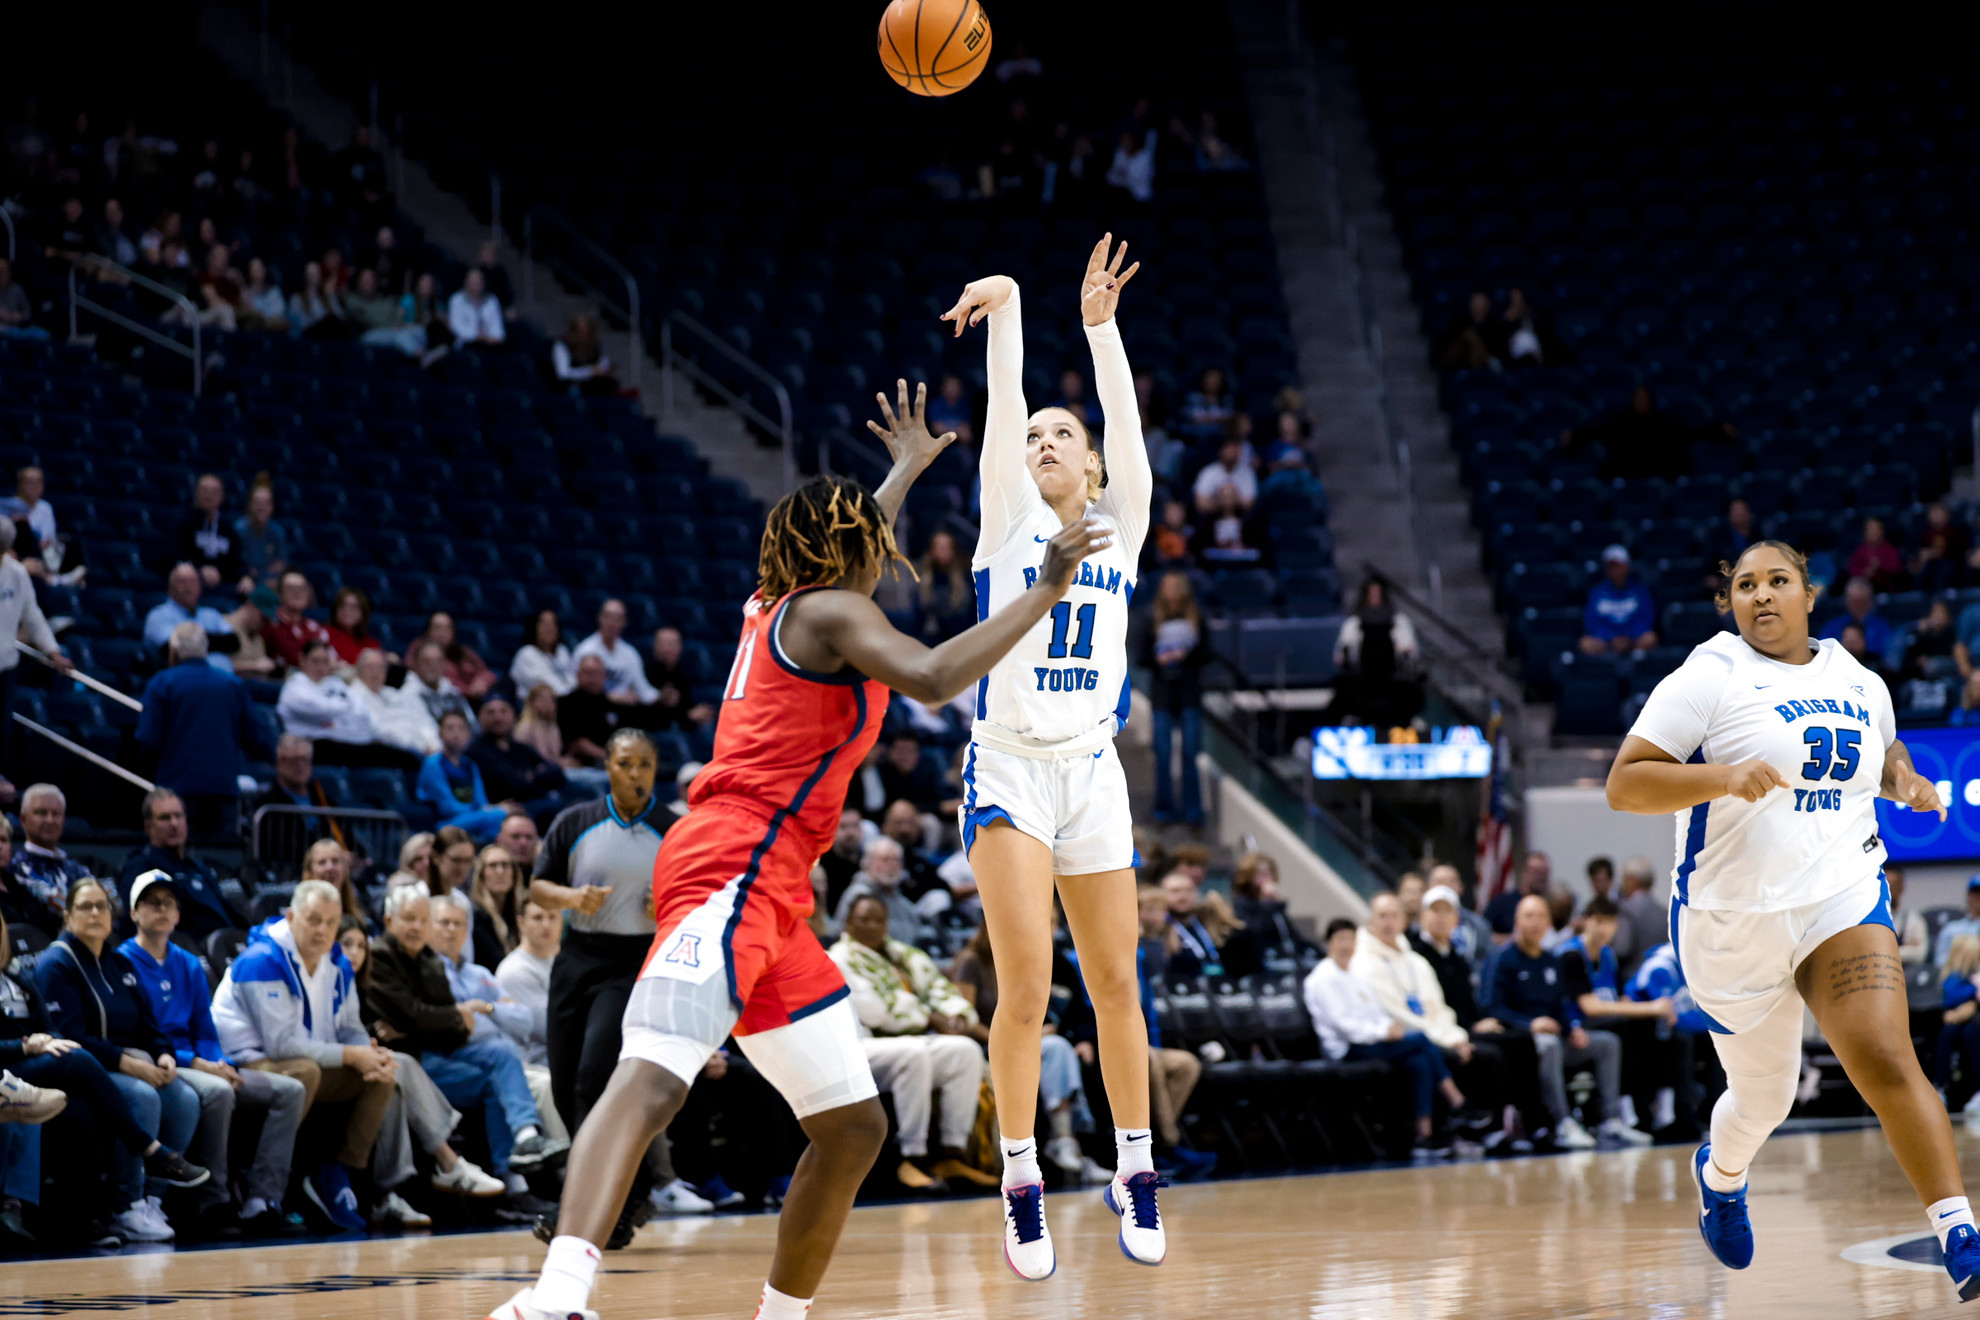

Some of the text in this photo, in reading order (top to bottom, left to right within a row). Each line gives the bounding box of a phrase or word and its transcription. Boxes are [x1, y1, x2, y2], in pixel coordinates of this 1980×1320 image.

[1023, 561, 1121, 595] BHAM
[1048, 601, 1097, 659] 11
[1034, 667, 1099, 692] YOUNG
[1774, 699, 1870, 727] BRIGHAM
[1801, 726, 1861, 781] 35
[1794, 788, 1842, 812] YOUNG
[665, 933, 701, 968] A
